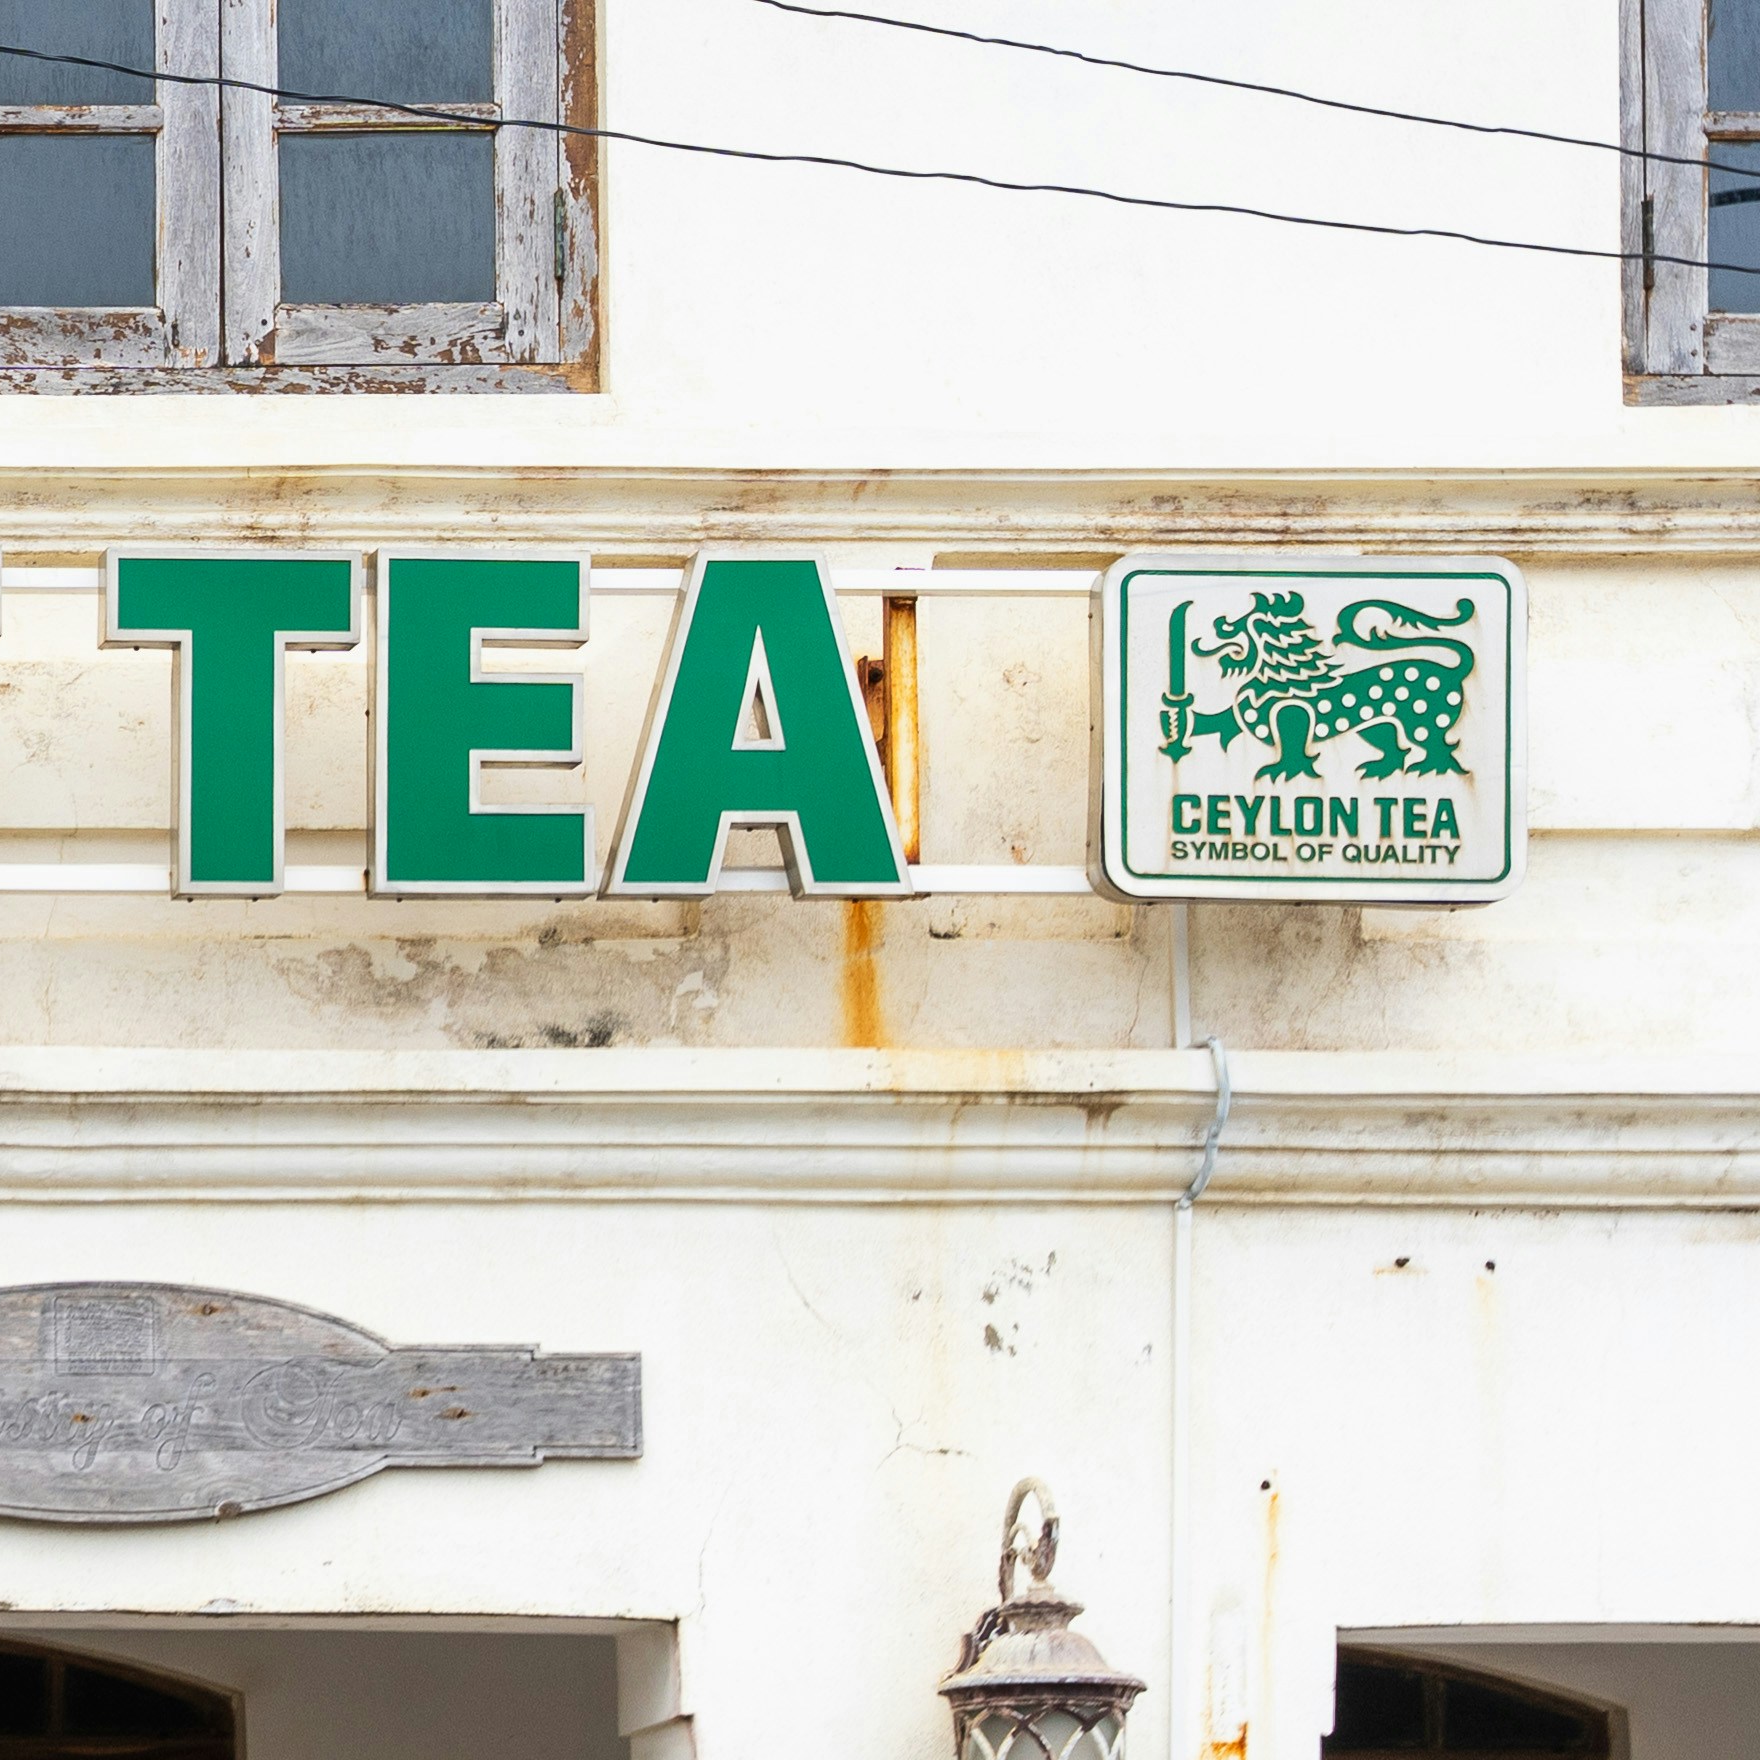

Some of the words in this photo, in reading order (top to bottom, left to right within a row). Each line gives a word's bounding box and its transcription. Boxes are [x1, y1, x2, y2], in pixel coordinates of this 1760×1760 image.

[98, 548, 920, 900] TEA
[1171, 793, 1359, 838] CEYLON
[1373, 797, 1461, 839] TEA
[1170, 841, 1288, 863] SYMBOL
[1296, 843, 1334, 864] OF
[1341, 844, 1461, 866] QUALITY
